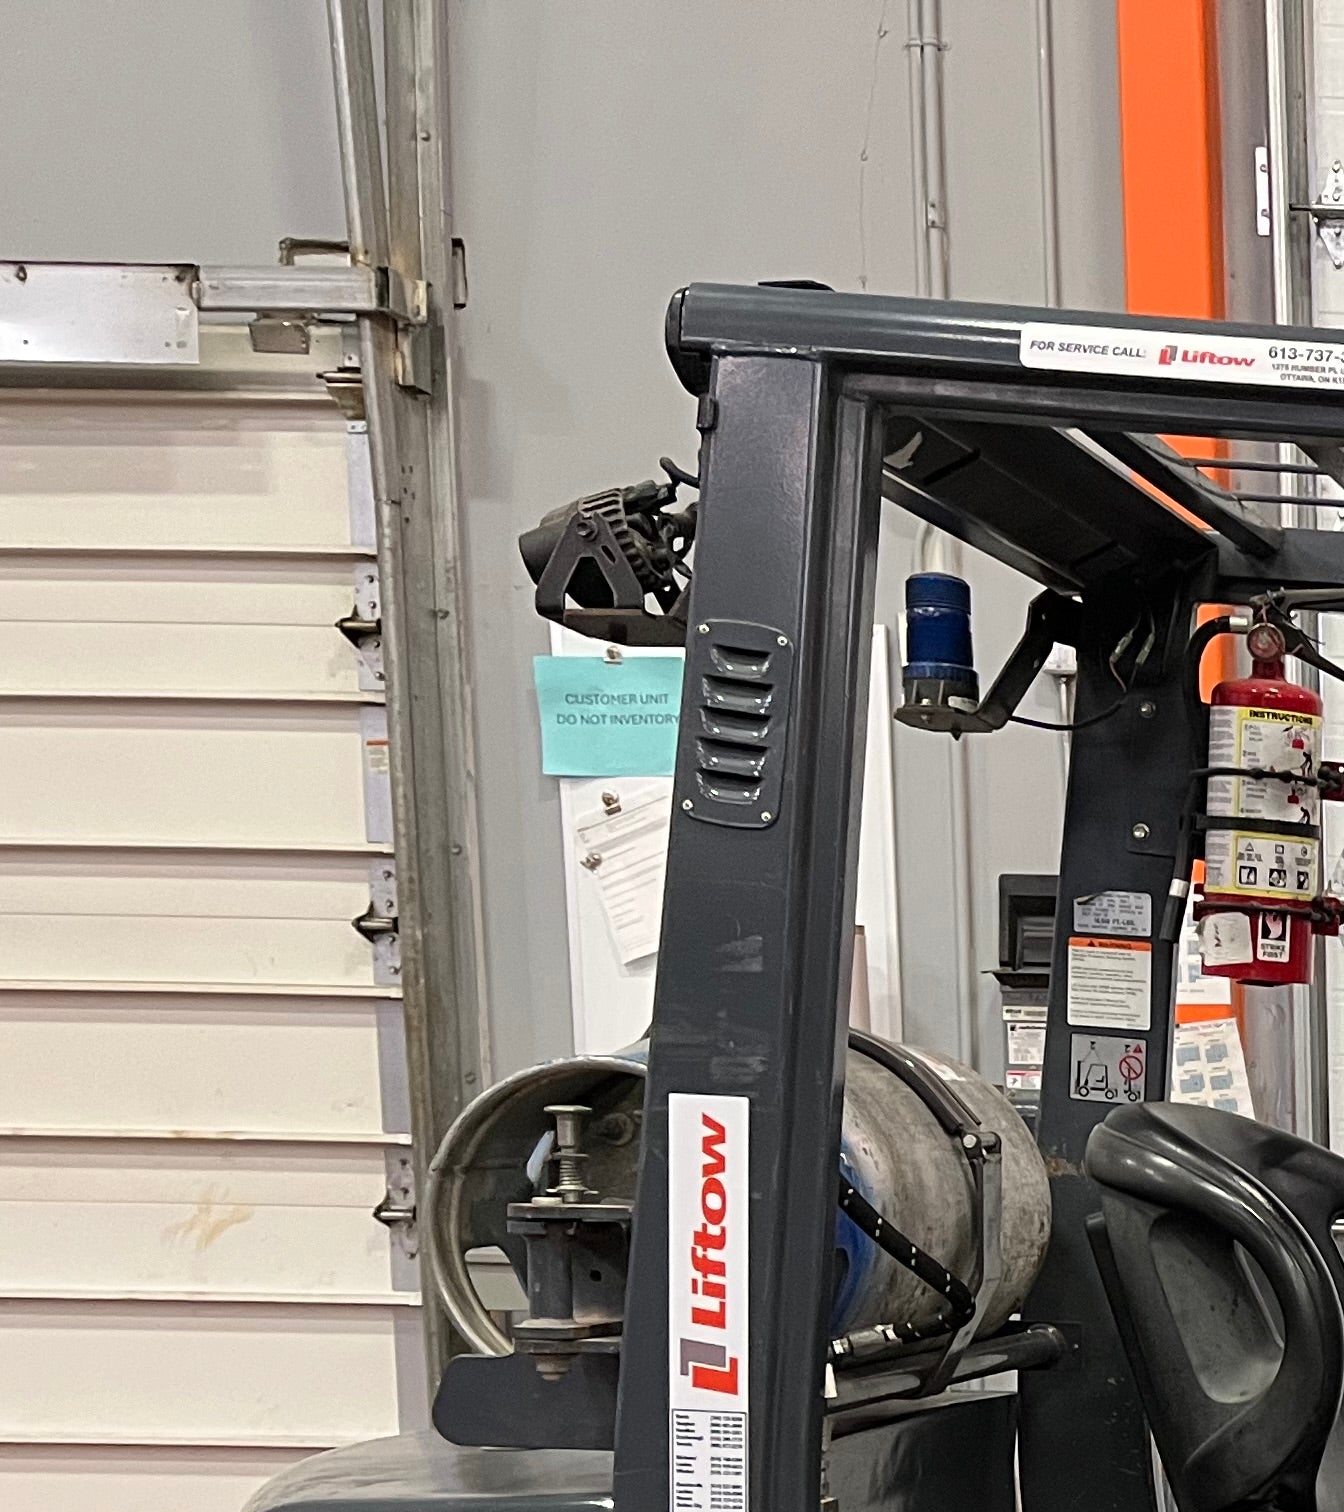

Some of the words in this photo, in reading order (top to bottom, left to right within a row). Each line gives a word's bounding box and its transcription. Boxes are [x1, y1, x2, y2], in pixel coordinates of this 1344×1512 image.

[1030, 340, 1055, 351] FOR
[1057, 342, 1109, 356] SERVICE
[1182, 350, 1255, 367] Liftow
[565, 693, 638, 705] CUSTOMER
[640, 693, 669, 704] UNIT
[557, 713, 577, 725] DO
[580, 714, 607, 725] NOT
[610, 714, 680, 725] INVENTORY
[1249, 710, 1313, 725] INSTRUCTIONS
[691, 1112, 727, 1330] Liftow
